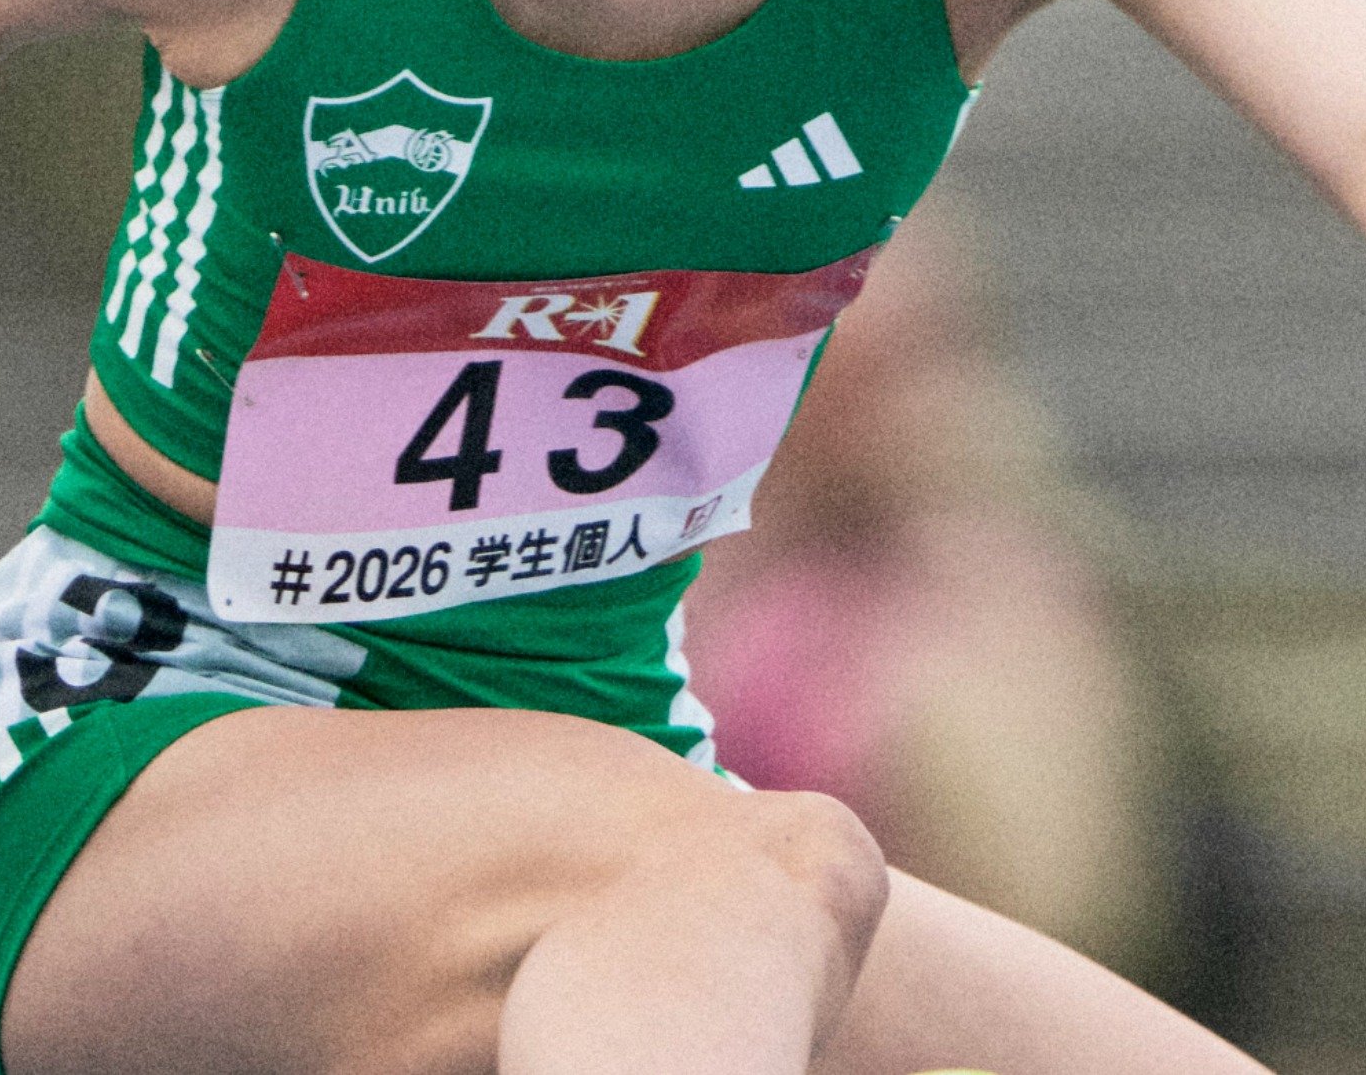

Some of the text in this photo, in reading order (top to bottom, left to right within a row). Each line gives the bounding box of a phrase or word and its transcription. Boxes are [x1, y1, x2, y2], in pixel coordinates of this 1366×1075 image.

[394, 360, 675, 512] 43
[464, 513, 649, 587] 学生個人
[15, 574, 189, 713] 3
